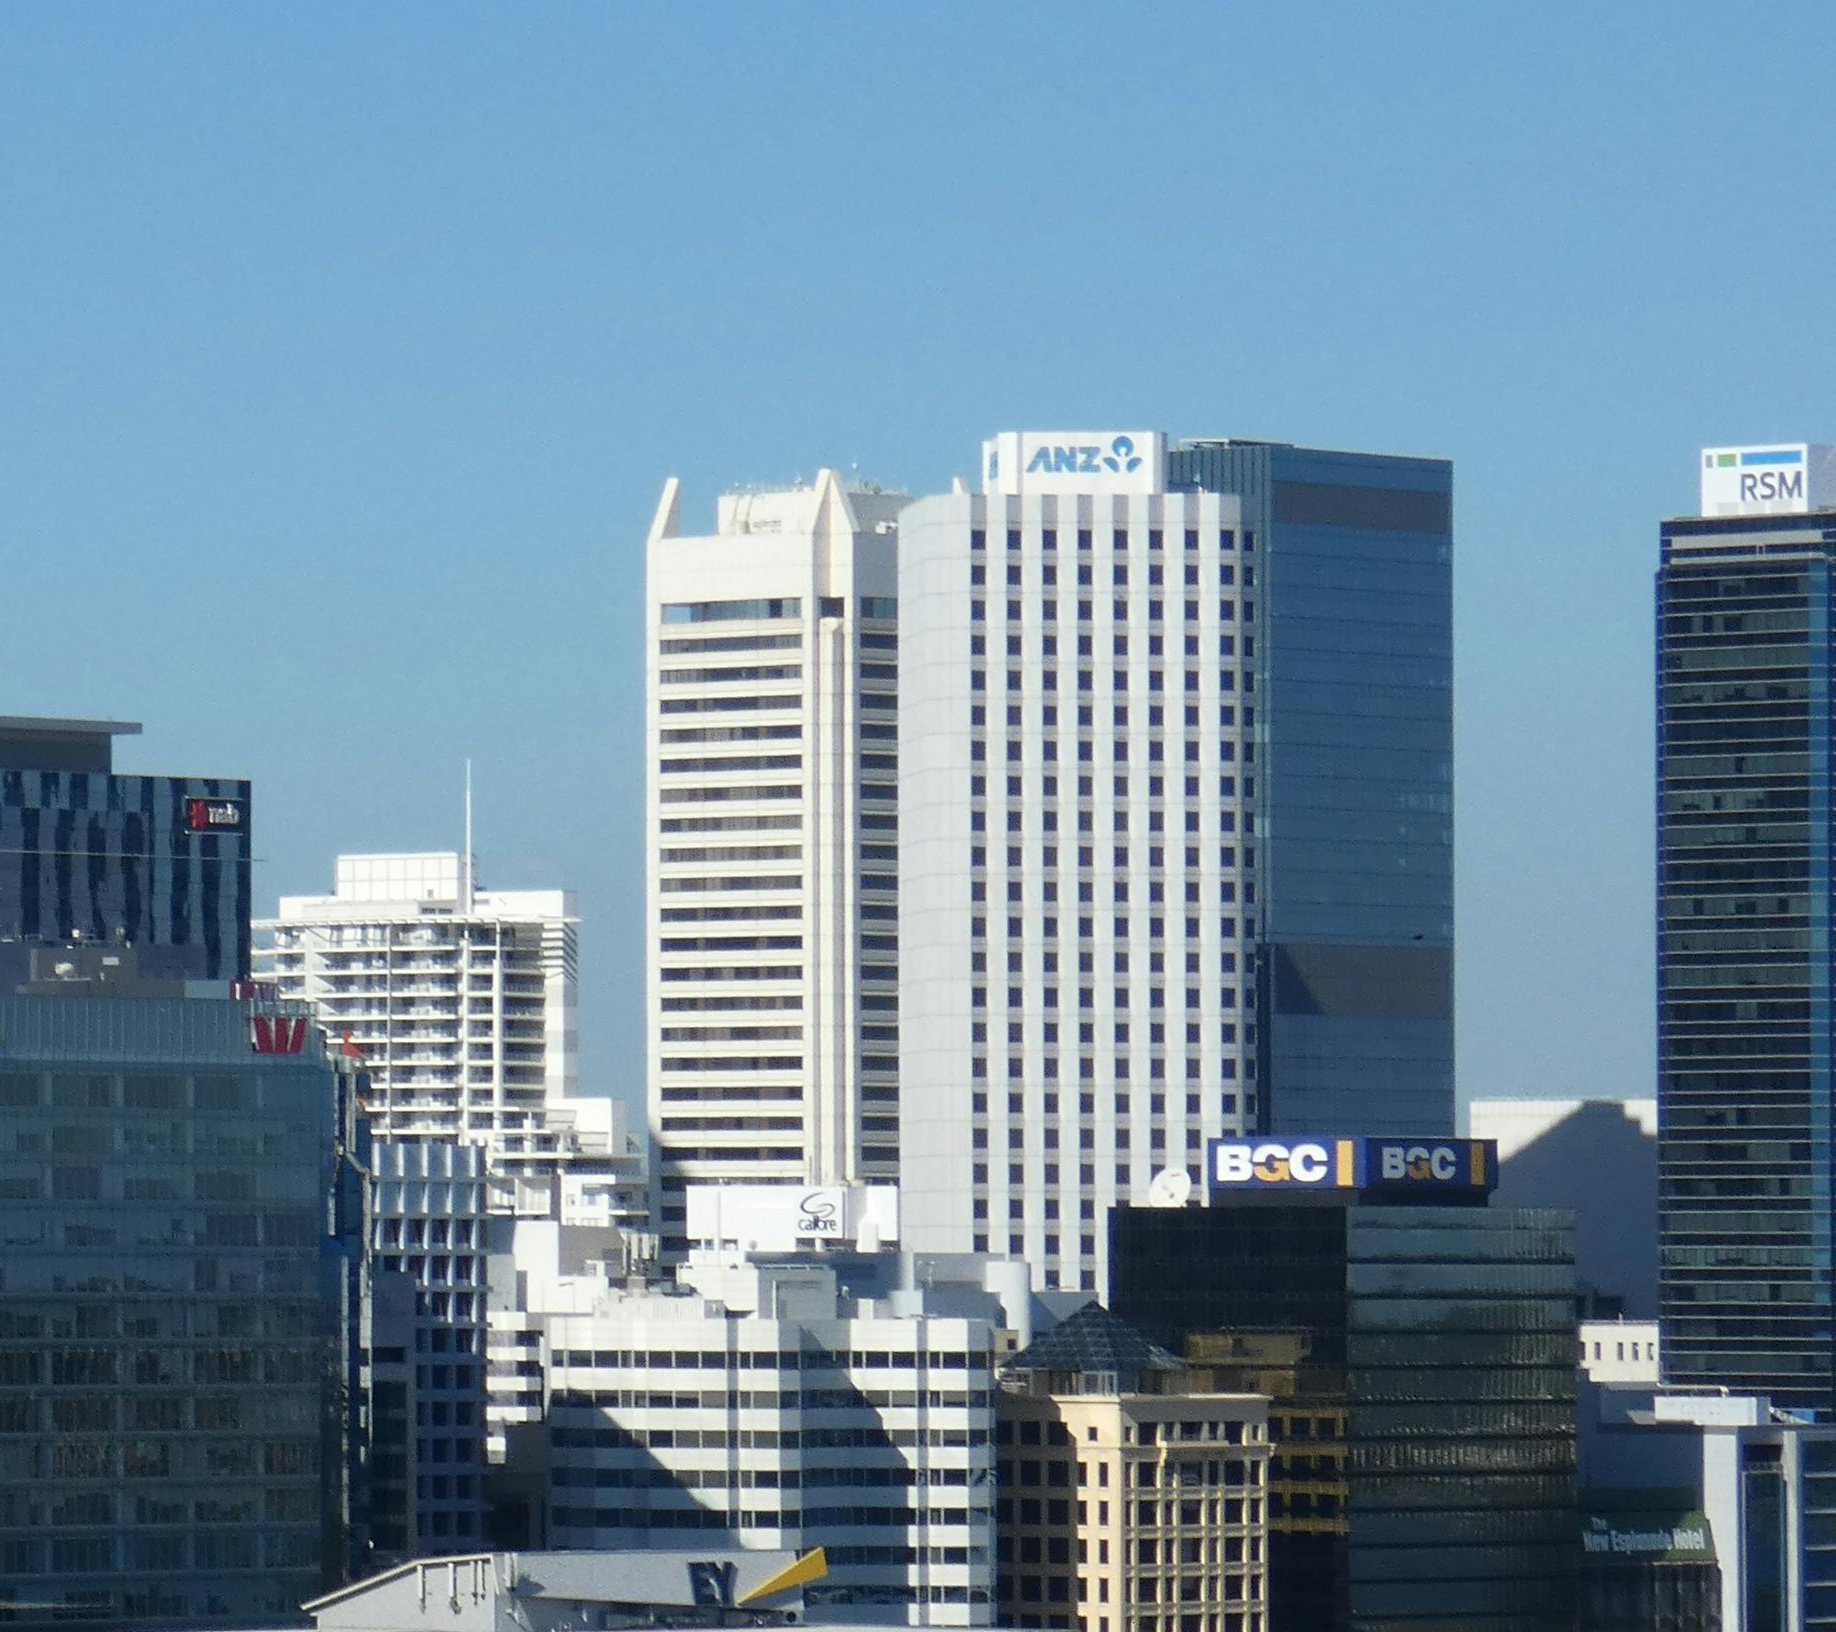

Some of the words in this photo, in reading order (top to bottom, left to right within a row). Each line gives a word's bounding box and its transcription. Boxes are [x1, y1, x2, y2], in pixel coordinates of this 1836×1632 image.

[1026, 446, 1101, 473] ANZ
[1741, 471, 1802, 501] RSM
[208, 803, 240, 824] nab
[1216, 1144, 1328, 1182] BGC
[1381, 1147, 1456, 1179] BGC
[1672, 1528, 1705, 1550] Hotel
[687, 1561, 738, 1606] EY
